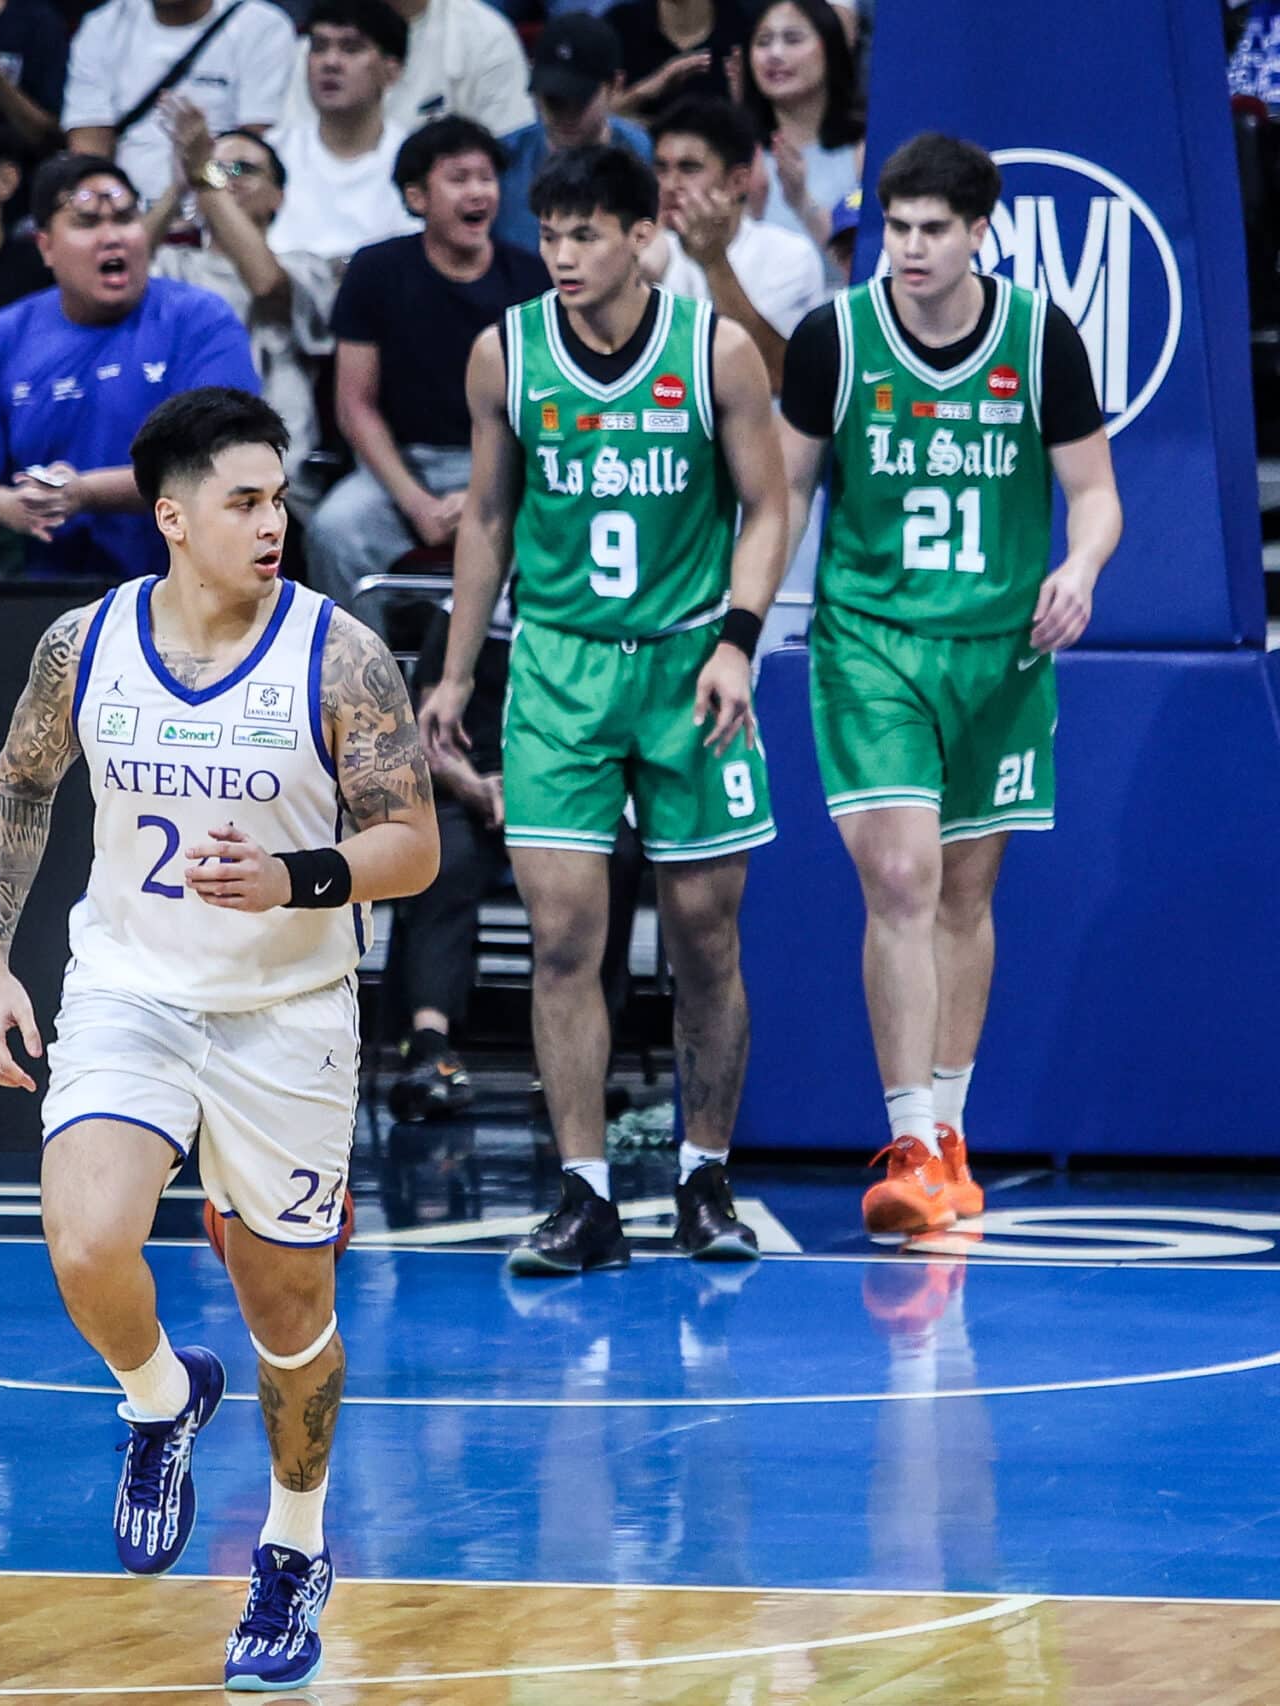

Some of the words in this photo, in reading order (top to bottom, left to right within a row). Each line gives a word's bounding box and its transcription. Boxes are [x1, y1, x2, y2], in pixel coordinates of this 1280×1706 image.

[536, 445, 584, 495] La
[591, 446, 689, 498] Salle
[866, 424, 916, 477] La
[926, 427, 1018, 480] Salle
[589, 510, 638, 599] 9
[903, 486, 985, 574] 21
[179, 728, 215, 742] Smart
[104, 757, 281, 802] ATENEO
[722, 760, 756, 818] 9
[993, 748, 1036, 807] 21
[276, 1168, 344, 1224] 24
